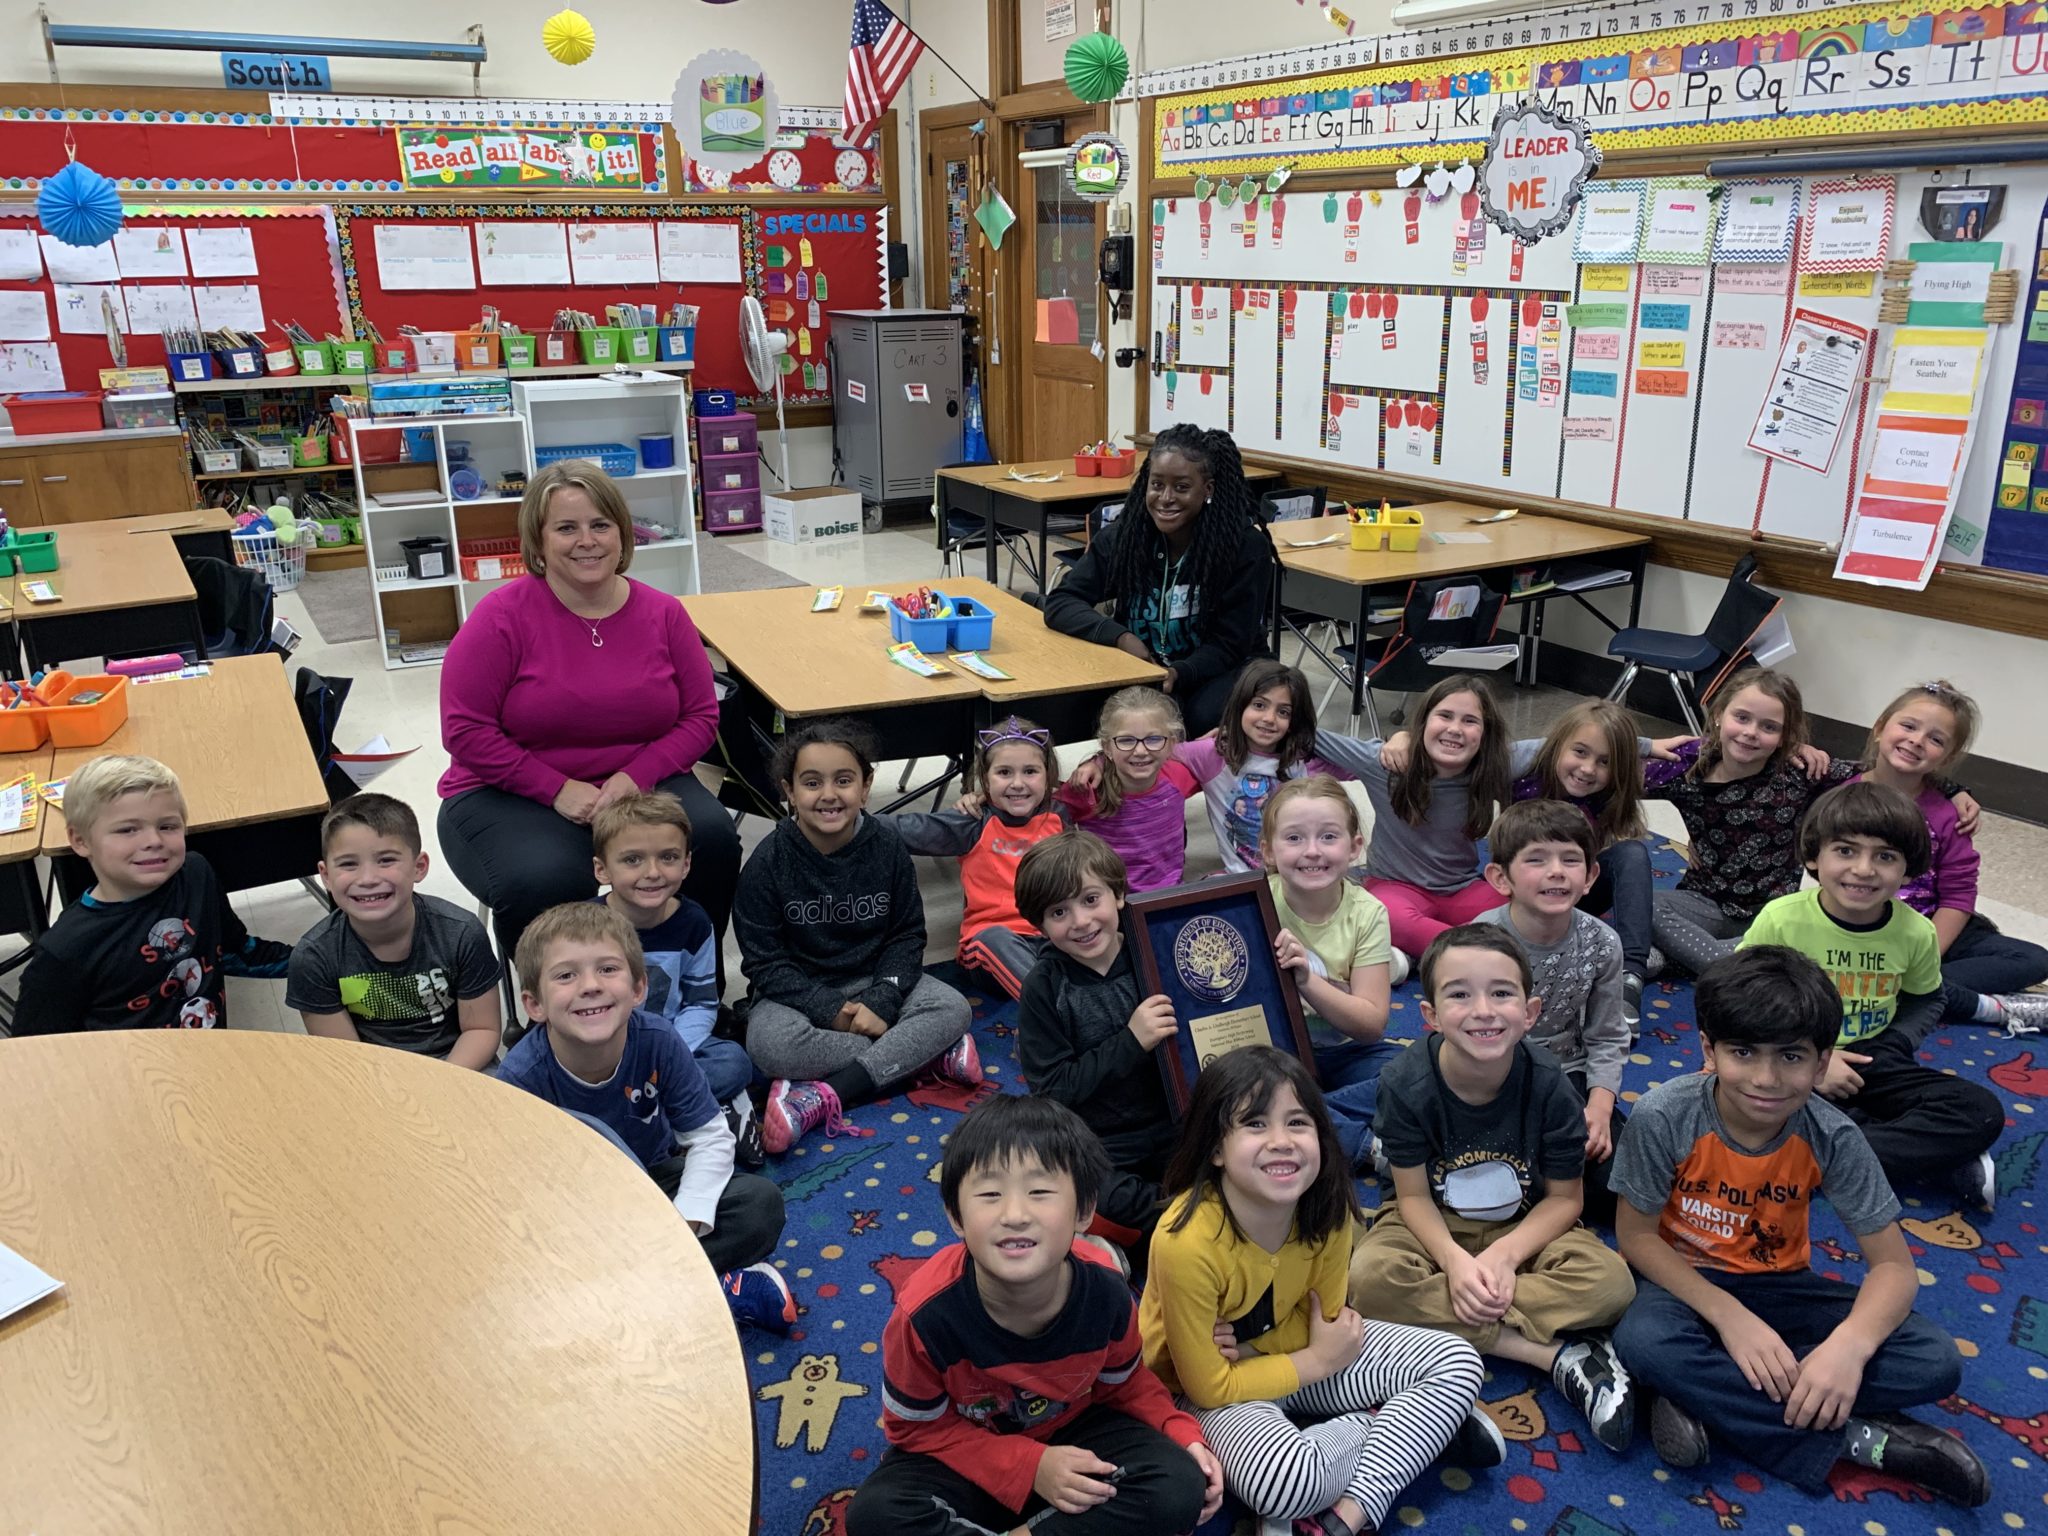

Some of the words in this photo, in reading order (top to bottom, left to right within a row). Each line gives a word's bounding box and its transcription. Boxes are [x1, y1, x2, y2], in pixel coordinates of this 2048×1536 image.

[1306, 60, 1314, 71] 56
[1321, 58, 1328, 68] 57
[1334, 55, 1341, 66] 58
[1348, 53, 1356, 64] 59
[1364, 50, 1372, 62] 60
[1385, 48, 1392, 59] 61
[1400, 46, 1409, 58] 62
[1416, 44, 1424, 56] 63
[1432, 41, 1441, 53] 64
[1450, 39, 1458, 52] 65
[1467, 37, 1476, 50] 66
[1484, 34, 1494, 48] 67
[1503, 32, 1512, 45] 68
[1521, 30, 1531, 43] 69
[1541, 28, 1550, 40] 70
[1560, 24, 1569, 38] 71
[1580, 22, 1591, 36] 72
[1607, 18, 1618, 32] 73
[1630, 15, 1640, 30] 74
[1651, 13, 1662, 27] 75
[1674, 10, 1686, 24] 76
[1698, 7, 1709, 20] 77
[1721, 4, 1734, 18] 78
[1744, 0, 1757, 15] 79
[1770, 0, 1783, 11] 80
[228, 58, 322, 86] South
[1162, 129, 1180, 150] Aa
[1184, 125, 1202, 149] Bb
[1208, 123, 1228, 146] Cc
[1234, 119, 1254, 144] Dd
[1261, 117, 1280, 142] Ee
[1289, 113, 1311, 140] Ff
[1317, 111, 1343, 148] Gg
[1350, 107, 1373, 135] Hh
[1384, 104, 1396, 133] Ii
[1416, 100, 1440, 142] Jj
[1454, 96, 1480, 127] Kk
[1584, 82, 1616, 115] Nn
[1629, 77, 1670, 111] Oo
[1685, 72, 1722, 120] Pp
[1736, 64, 1788, 114] Qq
[1804, 57, 1844, 95] Rr
[1869, 50, 1911, 88] Ss
[1941, 40, 1985, 82] Tt
[442, 110, 450, 119] 10
[460, 111, 467, 119] 11
[476, 111, 484, 120] 12
[496, 110, 504, 119] 13
[513, 110, 521, 119] 14
[529, 111, 537, 119] 15
[546, 111, 553, 120] 16
[562, 111, 570, 120] 17
[578, 111, 586, 120] 18
[594, 112, 601, 120] 19
[609, 112, 617, 120] 20
[624, 112, 632, 121] 21
[640, 112, 648, 121] 22
[655, 112, 663, 121] 23
[716, 112, 748, 130] Blue
[1517, 118, 1527, 136] A
[1504, 137, 1568, 158] LEADER
[410, 147, 478, 171] Read
[608, 150, 634, 170] it!
[1087, 169, 1101, 180] Red
[1508, 166, 1517, 176] is
[1531, 163, 1539, 175] in
[1839, 206, 1864, 215] Expand
[765, 214, 867, 235] SPECIALS
[1832, 214, 1868, 224] Vocabulary
[1802, 281, 1843, 292] Interesting
[1845, 281, 1866, 289] Words
[1924, 280, 1949, 289] Flying
[1952, 280, 1972, 289] High
[1801, 312, 1831, 326] Classroom
[933, 345, 947, 366] 3
[1910, 358, 1934, 366] Fasten
[1938, 359, 1958, 367] Your
[1916, 369, 1947, 378] Seatbelt
[2024, 410, 2030, 419] 3
[1900, 448, 1929, 457] Contact
[2015, 450, 2025, 459] 10
[1896, 458, 1928, 468] Co-Pilot
[2006, 492, 2016, 501] 17
[1872, 529, 1912, 541] Turbulence
[1948, 524, 1976, 547] Self
[1429, 590, 1467, 618] Max
[784, 892, 890, 924] adidas
[1177, 920, 1200, 970] DEPARTMENT
[1213, 919, 1245, 955] EDUCATION
[1826, 950, 1851, 967] I'M
[1859, 952, 1885, 970] THE
[1678, 1178, 1710, 1194] U.S.
[1681, 1197, 1749, 1228] VARSITY
